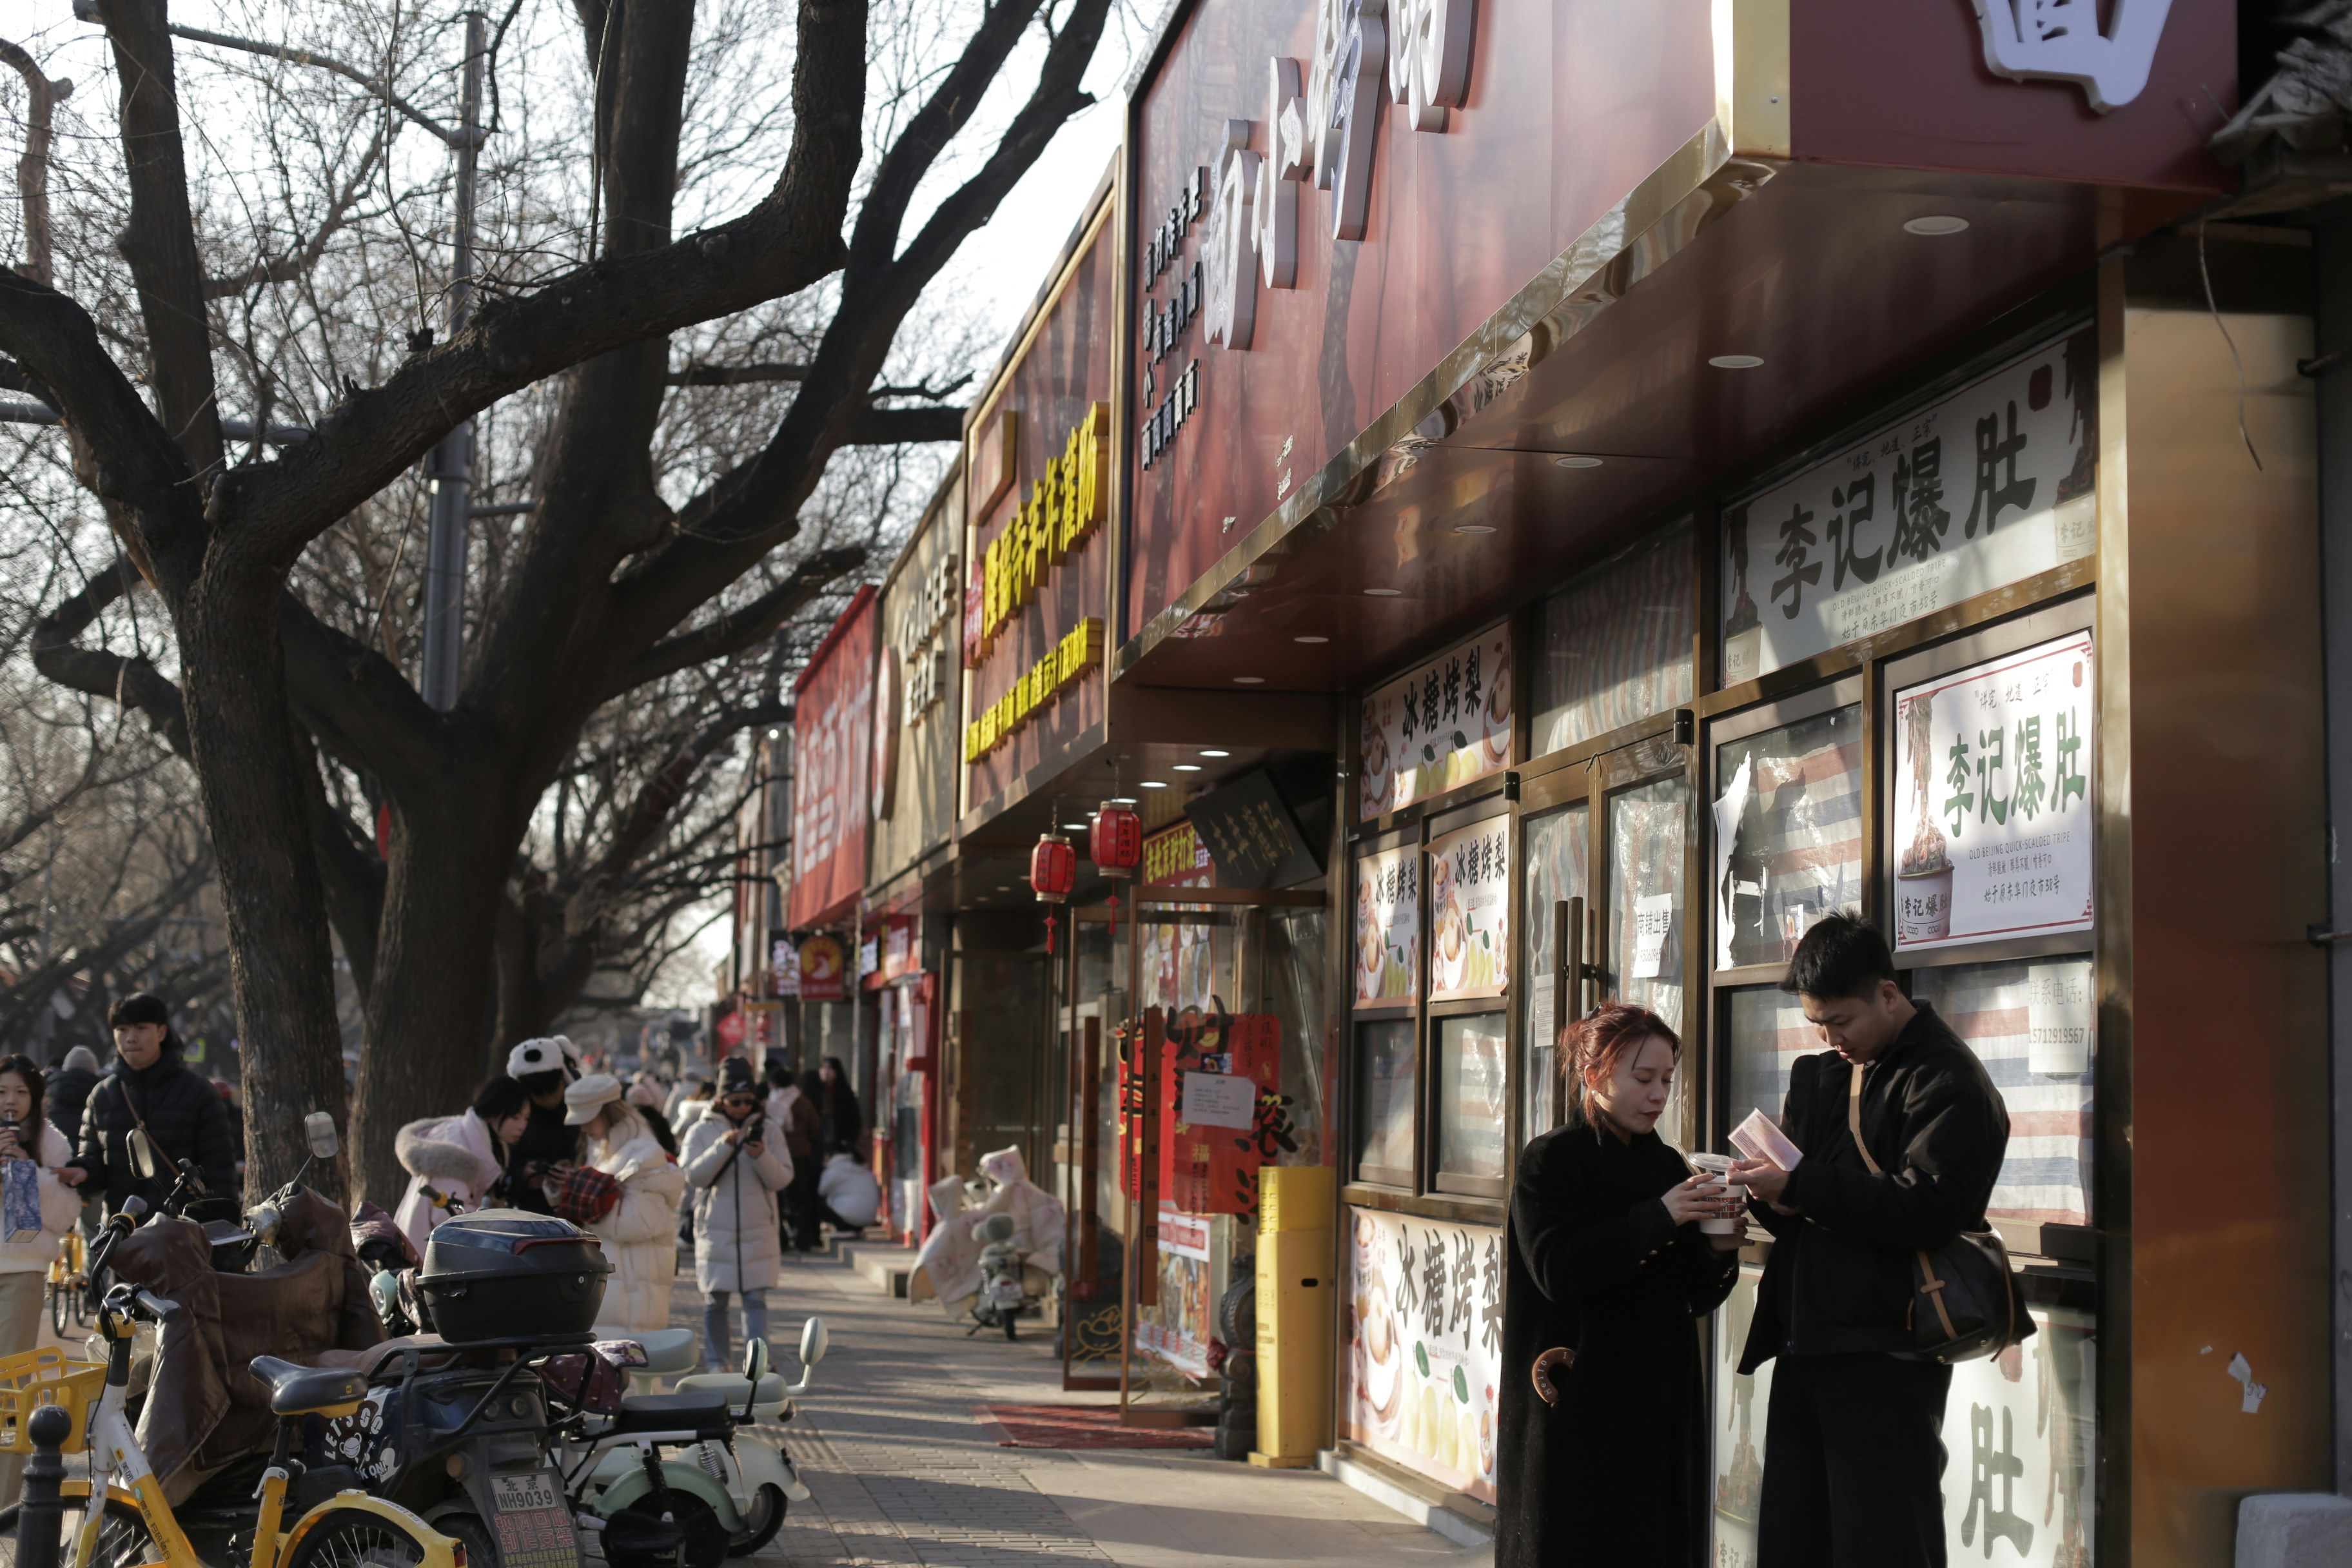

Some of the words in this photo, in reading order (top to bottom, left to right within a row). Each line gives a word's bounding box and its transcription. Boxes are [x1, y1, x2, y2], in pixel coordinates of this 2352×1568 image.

[1770, 400, 2037, 620] 李记爆肚
[1832, 600, 1845, 611] OLD
[1847, 590, 1870, 605] BEIJING
[1872, 567, 1924, 595] QUICK-SCALDED
[1927, 558, 1946, 574] TRIPE
[1402, 645, 1482, 743] 冰糖烤梨
[1945, 705, 2086, 838] 李记爆肚
[1455, 830, 1505, 888] 冰糖烤梨
[1969, 848, 1981, 859] OLD
[1983, 843, 2003, 858] BEIJING
[2005, 835, 2051, 854] QUICK-SCALDED
[2053, 831, 2070, 844] TRIPE
[1377, 857, 1416, 906] 冰糖烤梨
[1638, 908, 1670, 936] 商铺出售
[2029, 1027, 2084, 1044] 15712919567
[1396, 1223, 1504, 1360] 冰糖烤梨
[497, 1489, 553, 1509] NH9039
[505, 1478, 539, 1492] 北京
[500, 1527, 575, 1553] 制作安装
